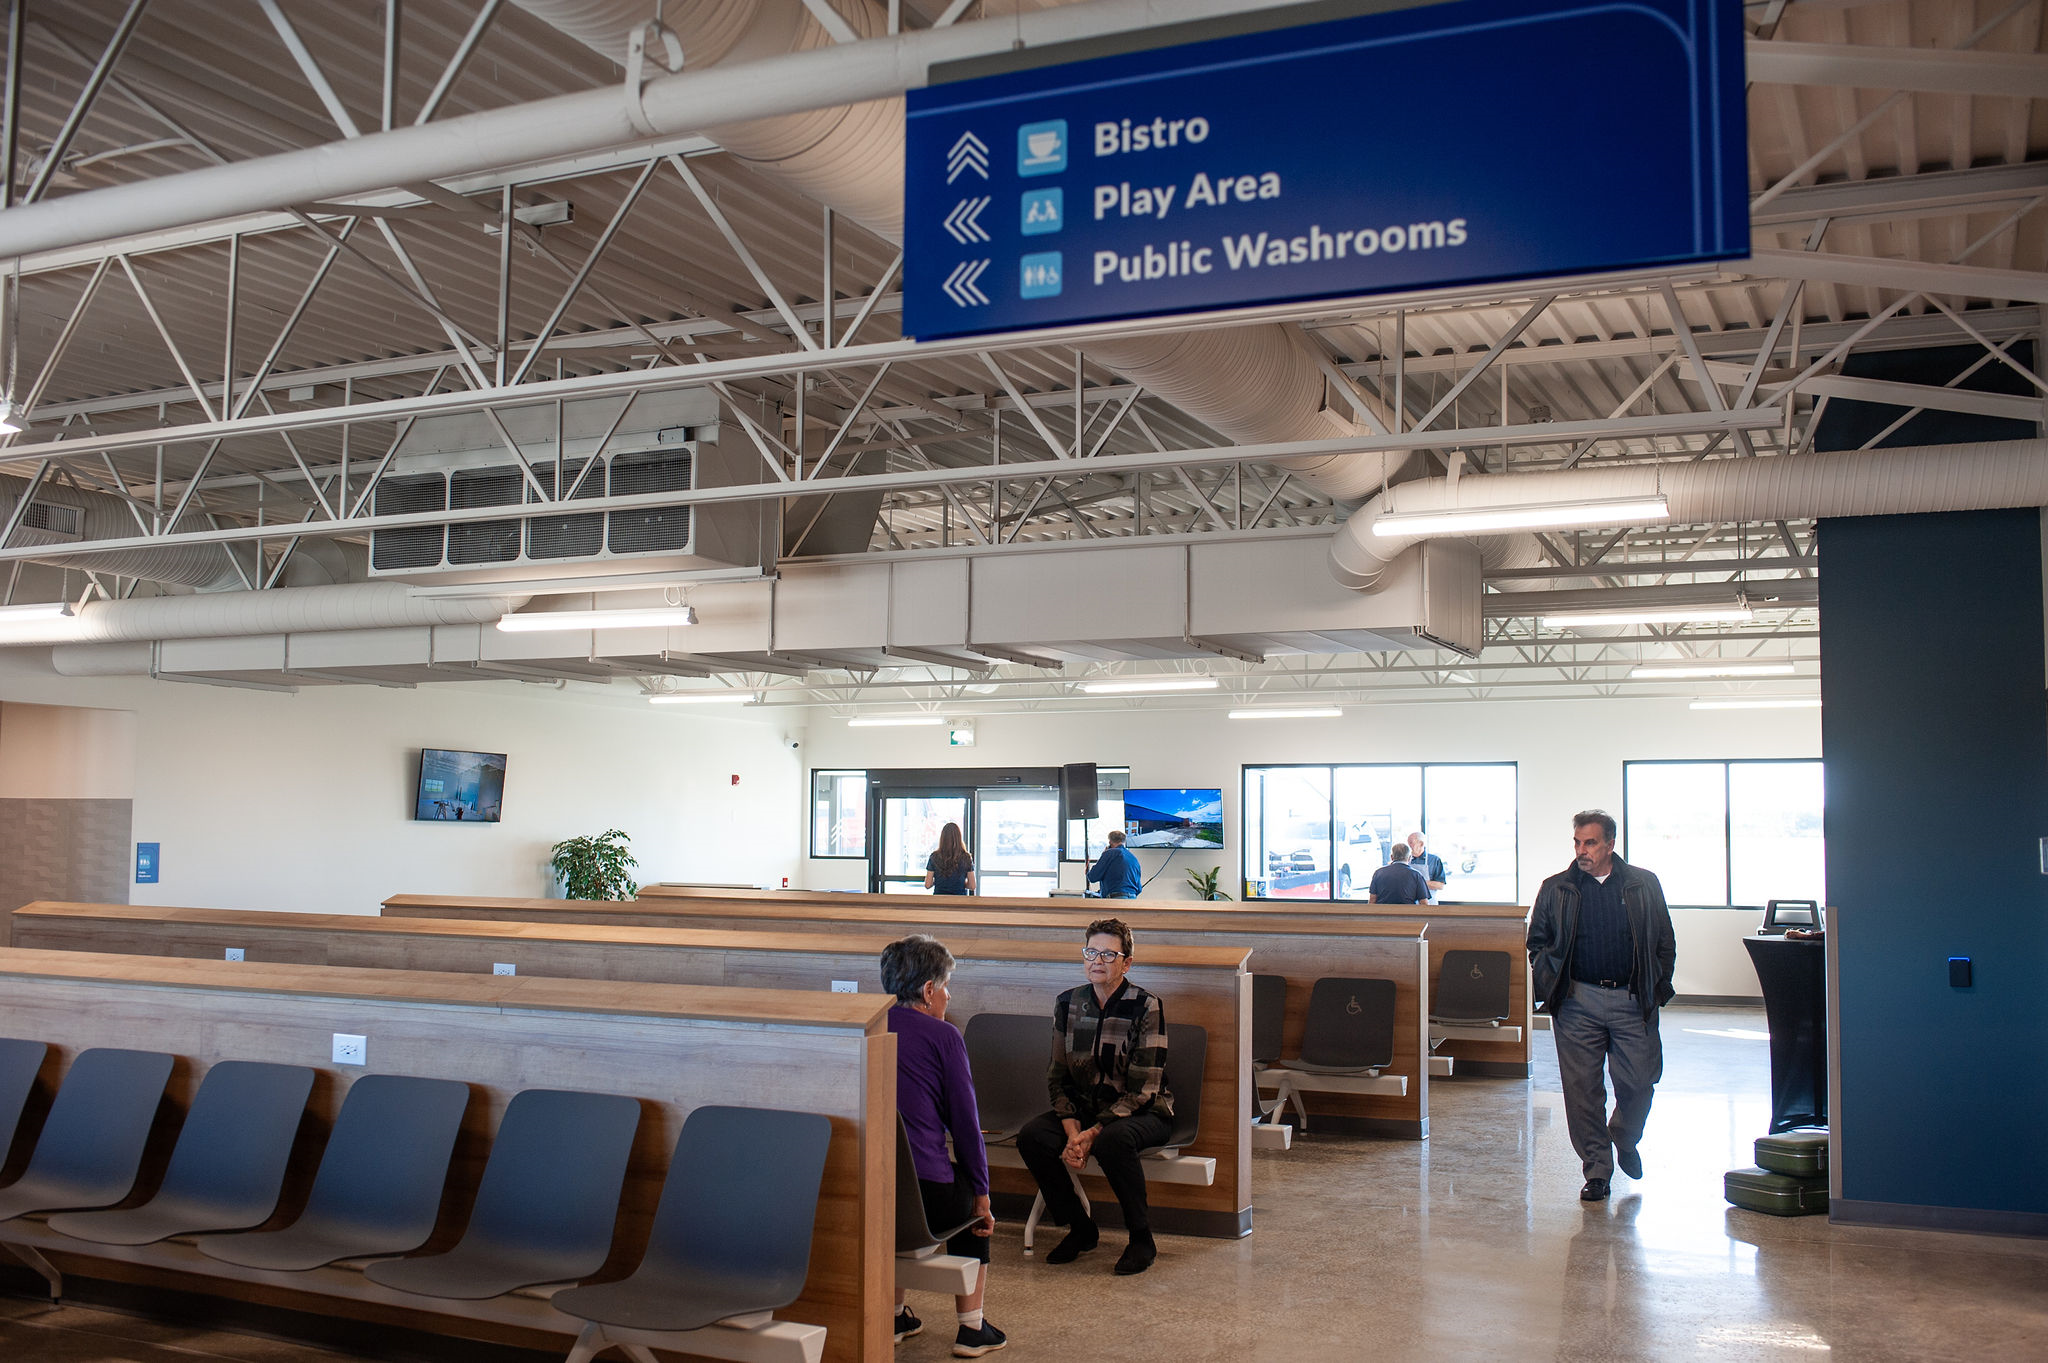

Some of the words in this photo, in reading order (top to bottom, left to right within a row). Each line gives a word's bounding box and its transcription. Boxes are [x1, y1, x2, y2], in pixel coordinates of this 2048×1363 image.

[1094, 117, 1209, 157] Bistro
[1094, 182, 1177, 221] Play
[1185, 173, 1281, 209] Area
[1093, 240, 1213, 286] Public
[1222, 218, 1468, 271] Washrooms
